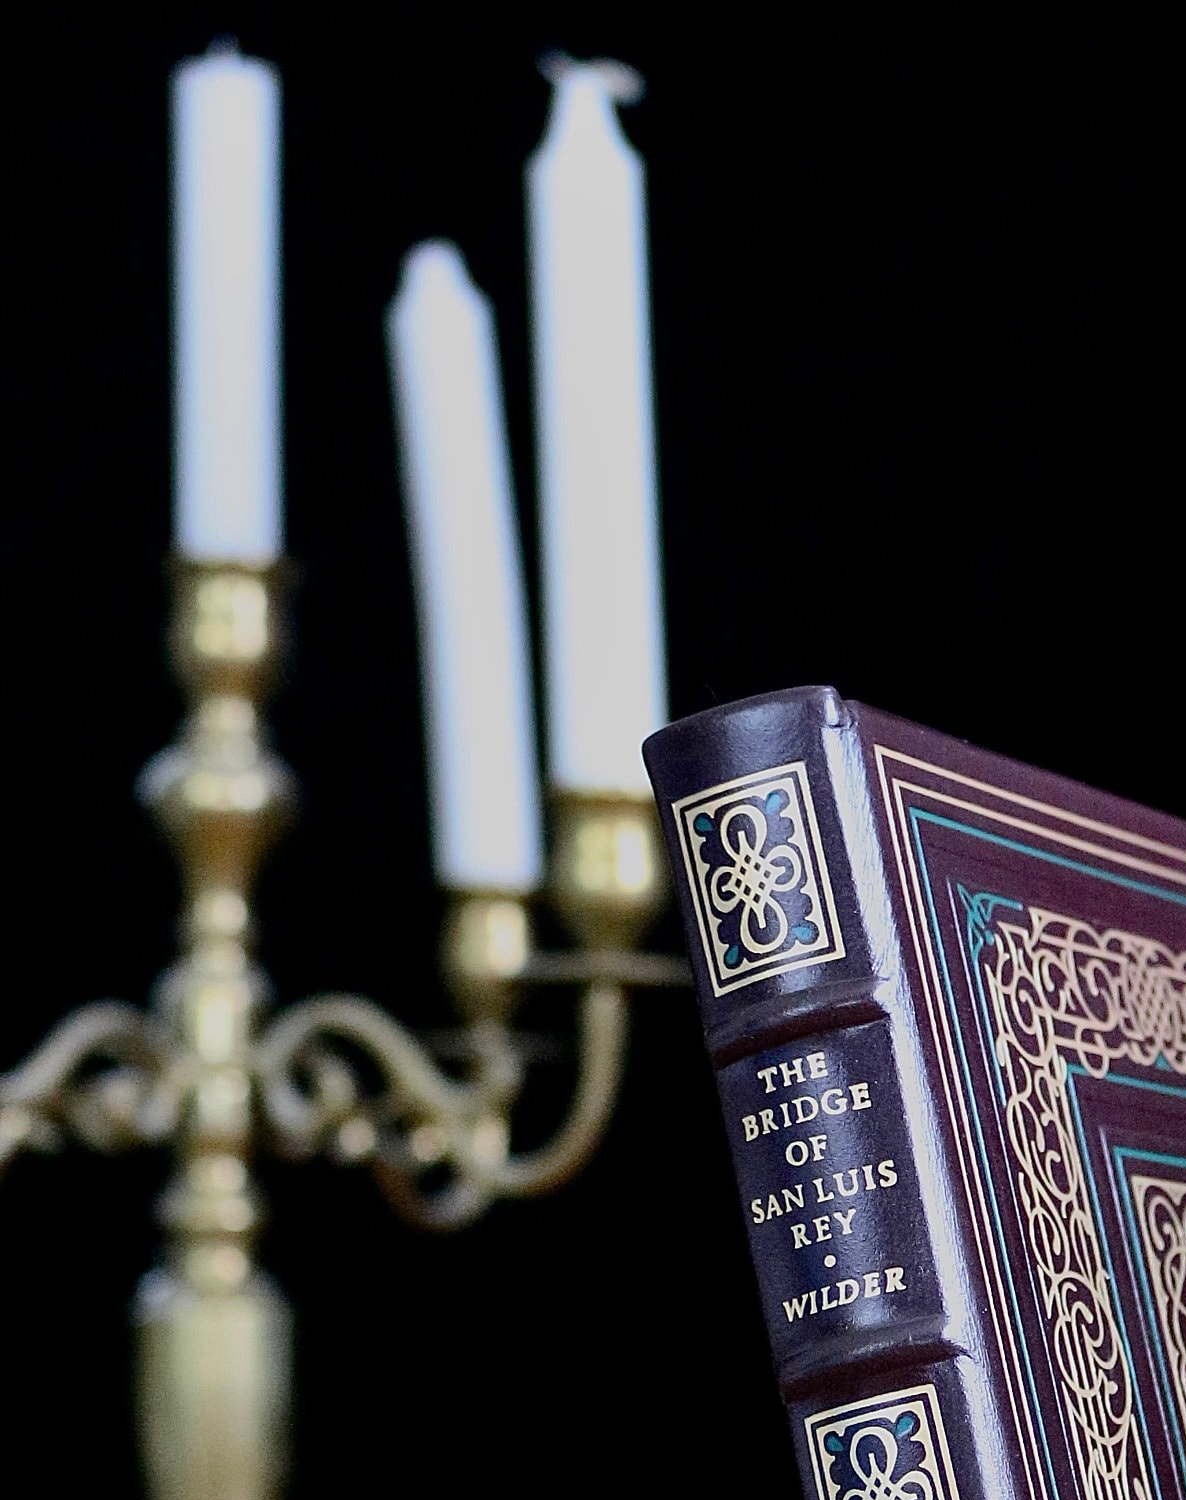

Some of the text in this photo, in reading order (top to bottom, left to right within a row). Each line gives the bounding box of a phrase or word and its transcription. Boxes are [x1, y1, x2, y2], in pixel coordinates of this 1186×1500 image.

[757, 1051, 829, 1093] THE
[741, 1082, 872, 1142] BRIDGE
[785, 1134, 827, 1167] OF
[751, 1159, 898, 1224] SAN LUIS
[790, 1209, 857, 1249] REY
[783, 1267, 907, 1323] WILDER
